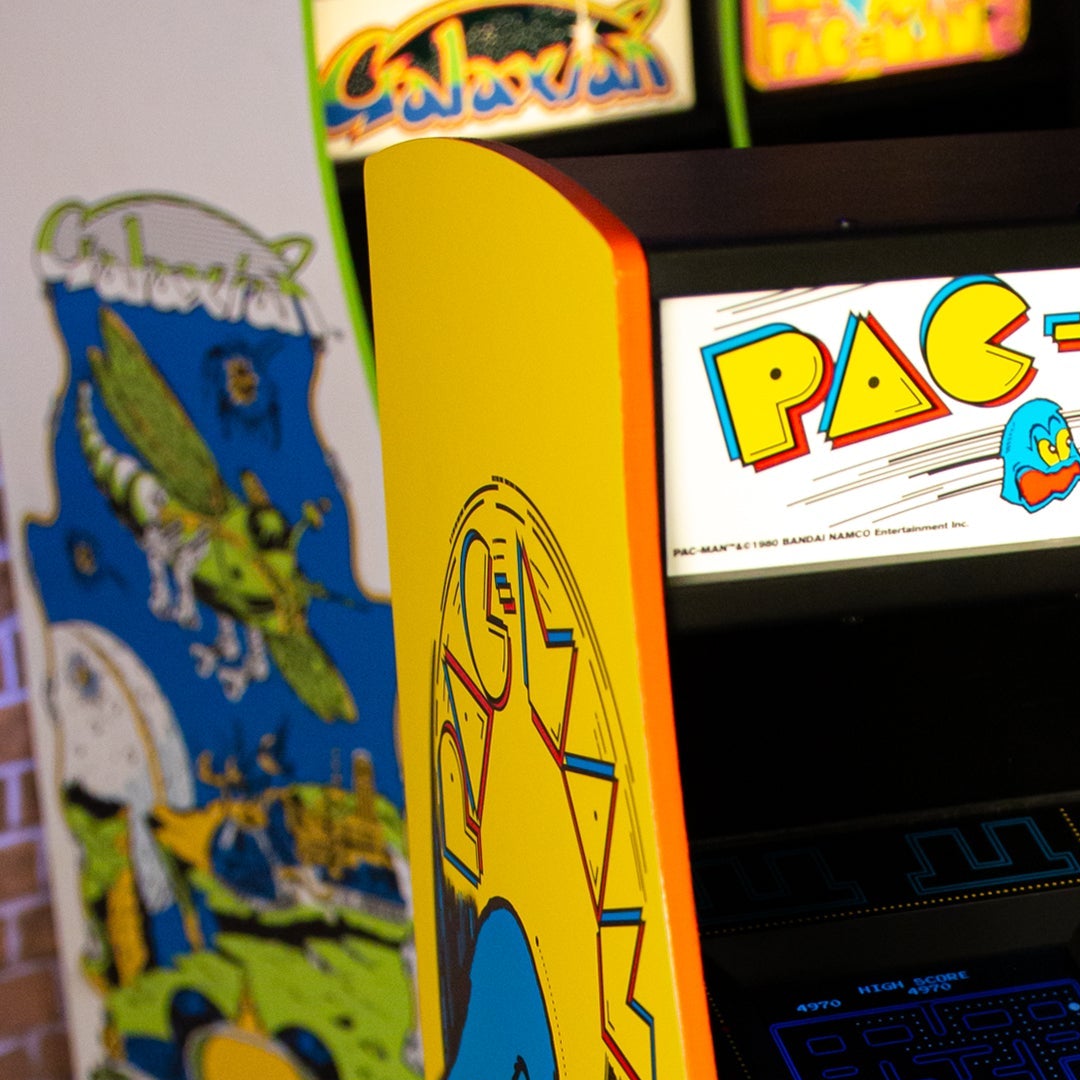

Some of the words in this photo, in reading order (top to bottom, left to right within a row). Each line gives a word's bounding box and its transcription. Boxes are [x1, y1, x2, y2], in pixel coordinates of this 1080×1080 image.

[782, 533, 826, 546] BANDAI
[829, 530, 871, 541] NAMCO
[874, 521, 949, 537] Entertainment
[951, 519, 969, 529] Inc.
[858, 980, 905, 995] HIGH
[913, 971, 970, 986] SCORE
[907, 982, 952, 996] 4970
[796, 999, 842, 1013] 4970
